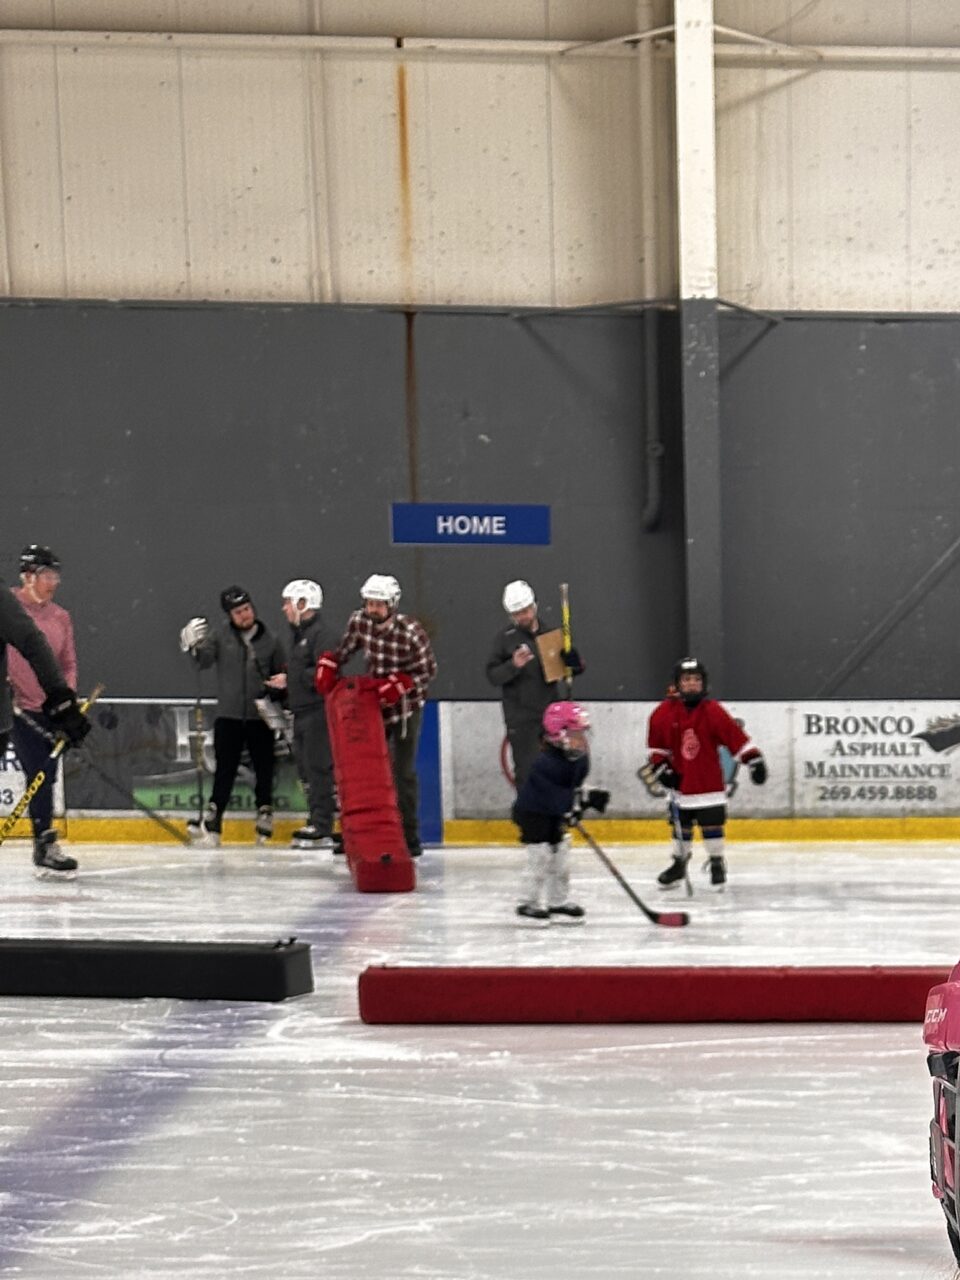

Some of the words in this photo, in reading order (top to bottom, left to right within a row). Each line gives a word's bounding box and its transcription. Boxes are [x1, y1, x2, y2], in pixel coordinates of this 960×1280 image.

[436, 515, 506, 535] HOME
[804, 713, 915, 736] BRONCO
[830, 739, 922, 757] ASPHALT
[804, 761, 952, 779] MAINTENANCE
